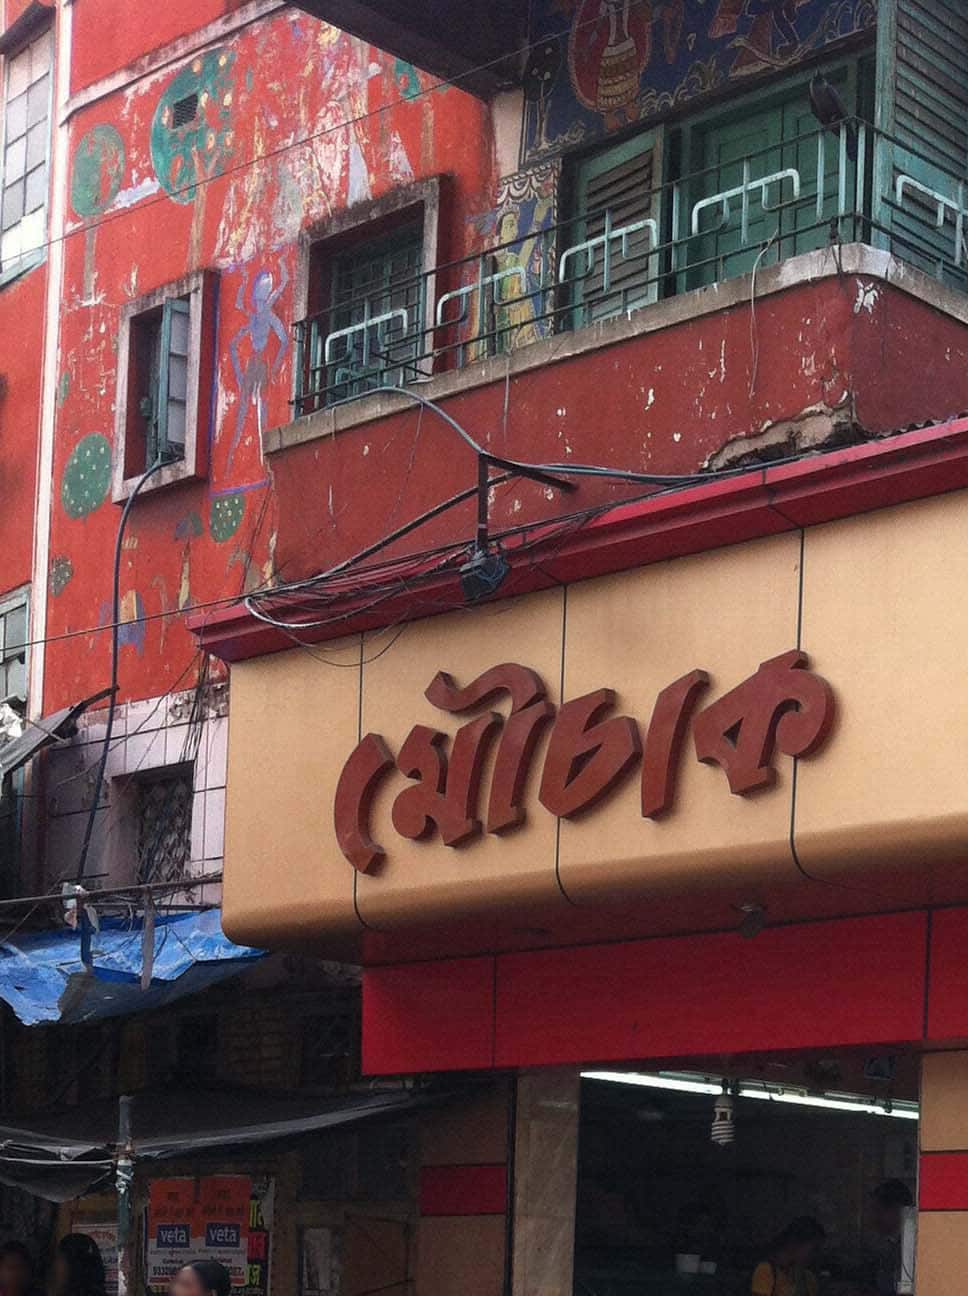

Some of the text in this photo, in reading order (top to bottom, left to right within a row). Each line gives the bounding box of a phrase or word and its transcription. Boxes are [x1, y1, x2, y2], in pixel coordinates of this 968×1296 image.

[334, 649, 837, 876] মৌচাক
[160, 1227, 187, 1243] veta
[209, 1224, 237, 1242] veta
